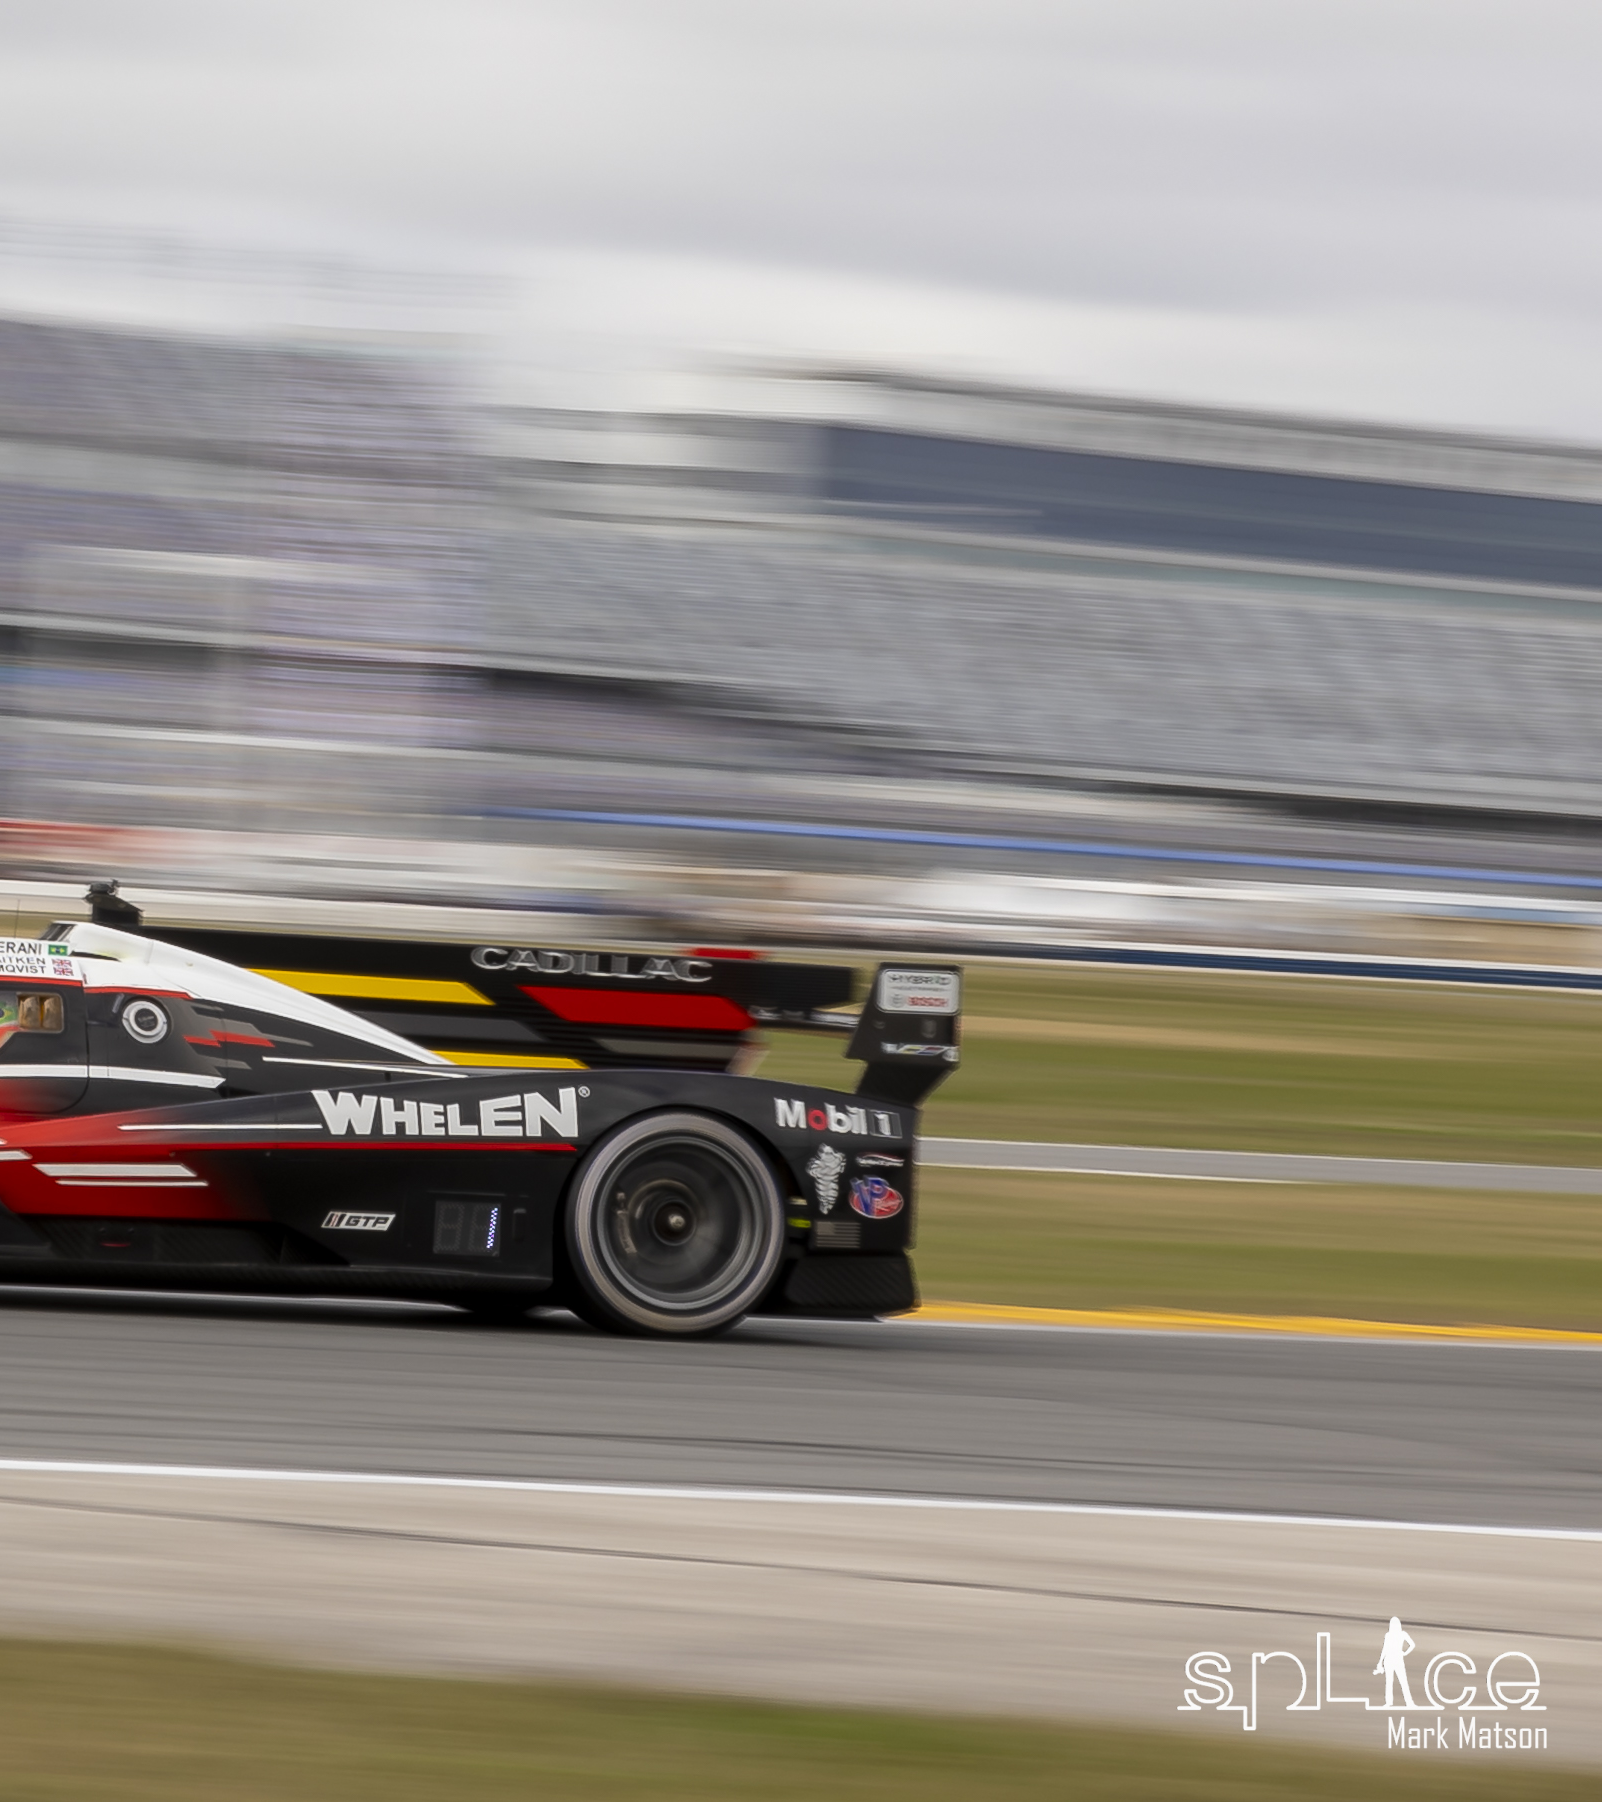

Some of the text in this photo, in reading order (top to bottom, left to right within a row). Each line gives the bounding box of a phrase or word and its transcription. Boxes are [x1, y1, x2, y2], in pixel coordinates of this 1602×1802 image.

[471, 948, 713, 982] CADILLAC
[311, 1087, 578, 1138] WHELEN
[774, 1097, 892, 1136] Mobil 1
[346, 1215, 391, 1229] GTP
